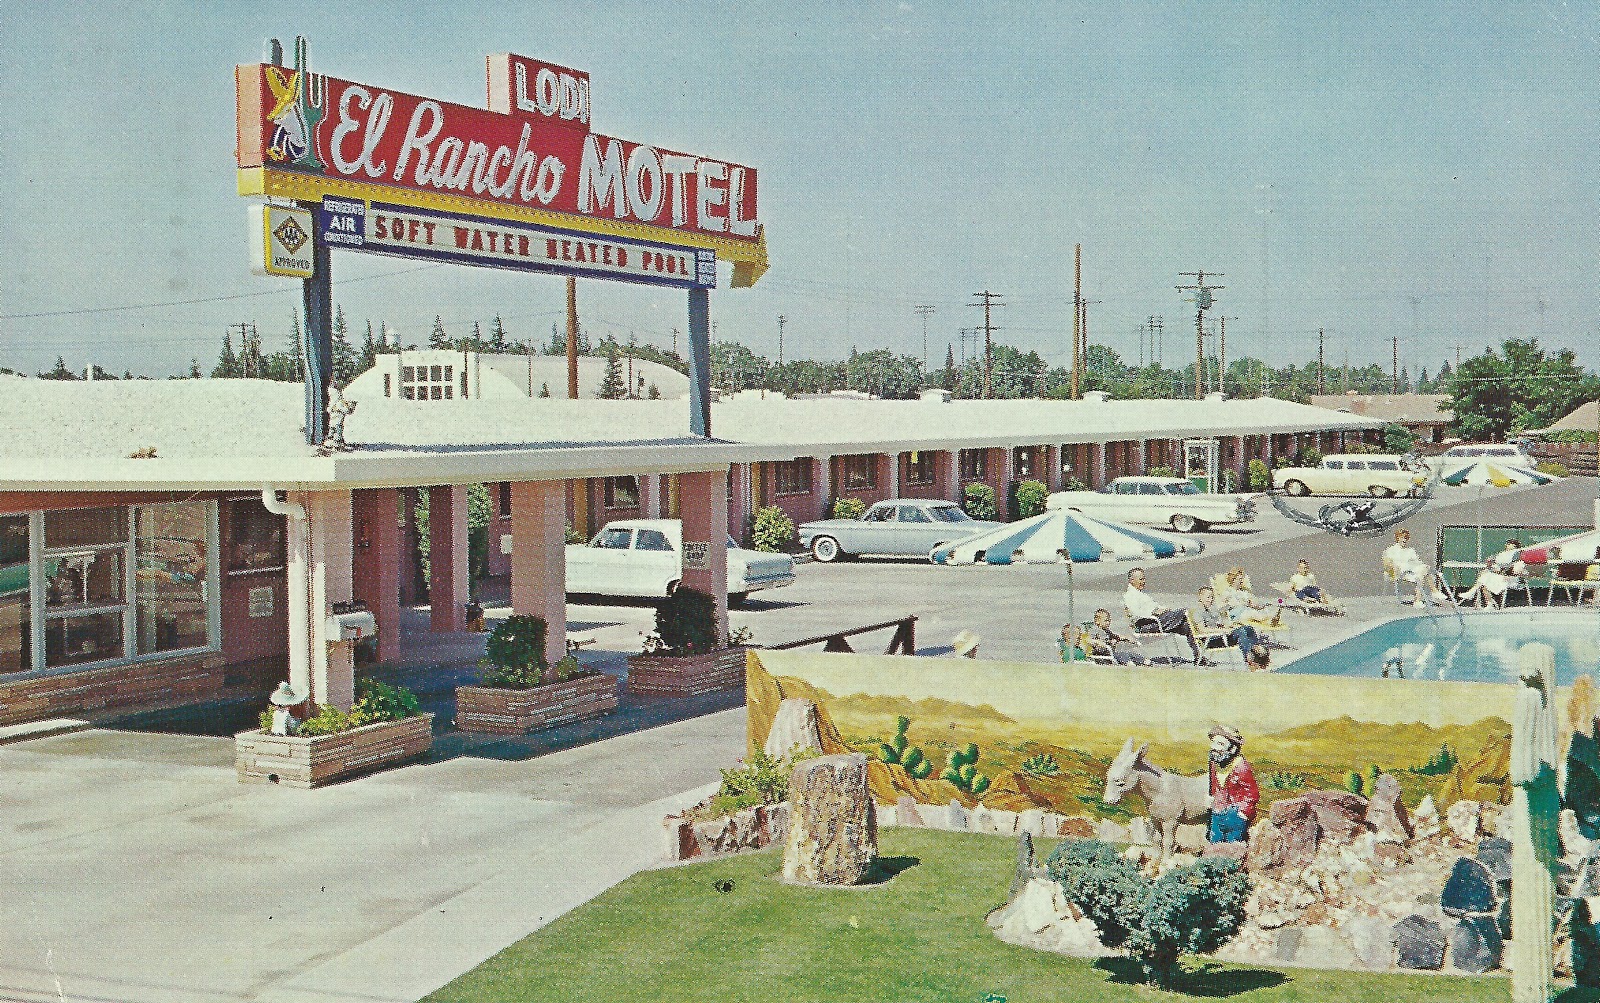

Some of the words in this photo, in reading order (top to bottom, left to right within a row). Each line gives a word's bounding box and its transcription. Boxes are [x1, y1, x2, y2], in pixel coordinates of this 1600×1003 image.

[514, 62, 589, 123] LODI
[331, 86, 394, 177] El
[393, 101, 566, 205] Rancho
[577, 134, 758, 237] MOTEL
[330, 215, 356, 232] AIR
[375, 215, 436, 245] SOFT
[453, 226, 531, 256] WATER
[546, 239, 628, 267] HEATED
[642, 251, 689, 276] POOL
[274, 256, 310, 270] APPROVED
